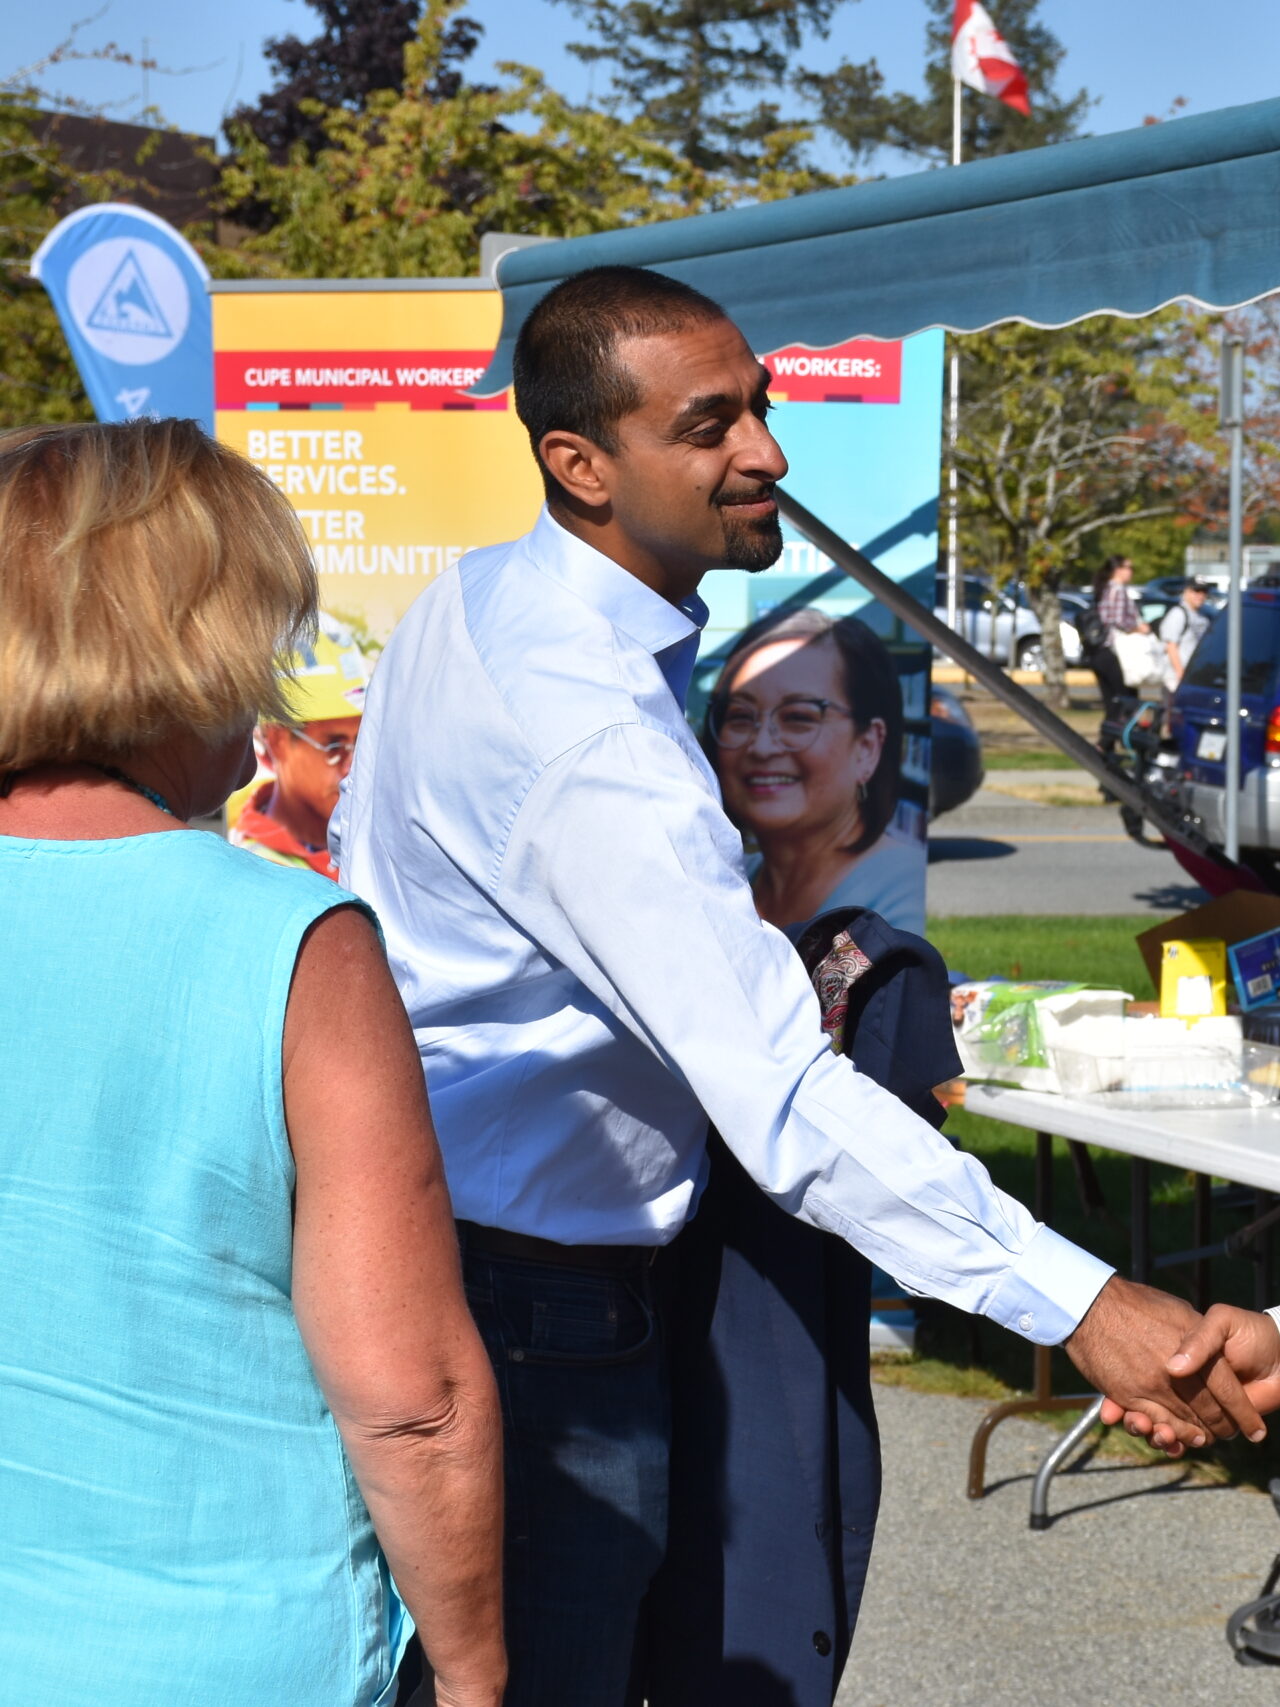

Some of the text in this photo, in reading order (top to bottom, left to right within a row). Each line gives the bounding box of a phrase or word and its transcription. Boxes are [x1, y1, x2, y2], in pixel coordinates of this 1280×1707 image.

[245, 368, 290, 386] CUPE
[296, 368, 393, 386] MUNICIPAL
[774, 357, 881, 377] WORKERS:
[248, 430, 363, 459] BETTER
[254, 464, 406, 495] ERVICES.
